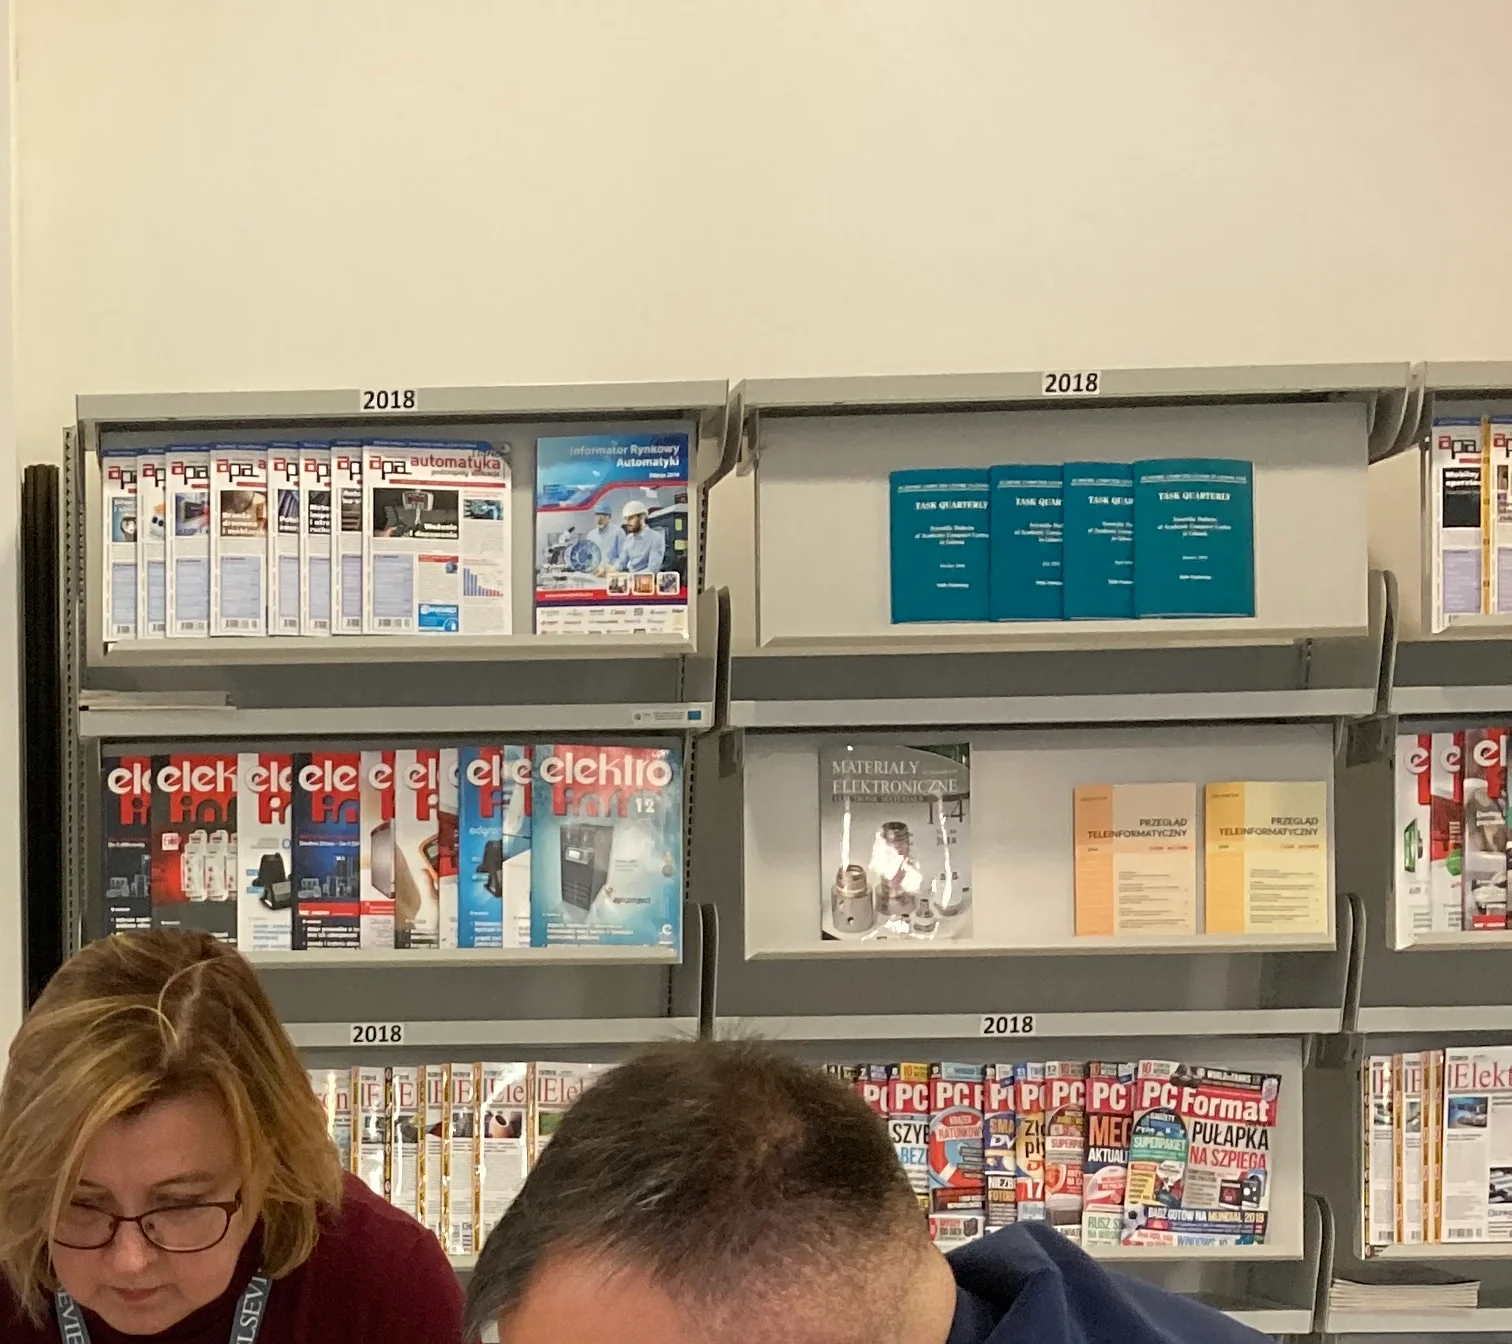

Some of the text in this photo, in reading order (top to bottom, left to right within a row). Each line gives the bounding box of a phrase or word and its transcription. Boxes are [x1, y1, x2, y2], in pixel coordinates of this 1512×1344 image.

[1044, 372, 1099, 393] 2018
[363, 390, 415, 409] 2018
[570, 444, 680, 456] Informator Rynkowy
[410, 454, 501, 473] automatyka
[616, 456, 680, 468] Automatyki
[915, 501, 937, 510] TASK
[1157, 491, 1231, 501] TASK QUARTERLY
[539, 752, 673, 787] elektro
[832, 778, 958, 794] ELEKTRONICZNE
[353, 1025, 403, 1043] 2018
[983, 1016, 1034, 1034] 2018
[895, 1082, 929, 1111] PC
[1092, 1082, 1127, 1111] PC
[1142, 1080, 1270, 1122] PC Format
[1192, 1121, 1270, 1150] PUŁAPKA
[1189, 1145, 1266, 1170] NA SZPIEGA
